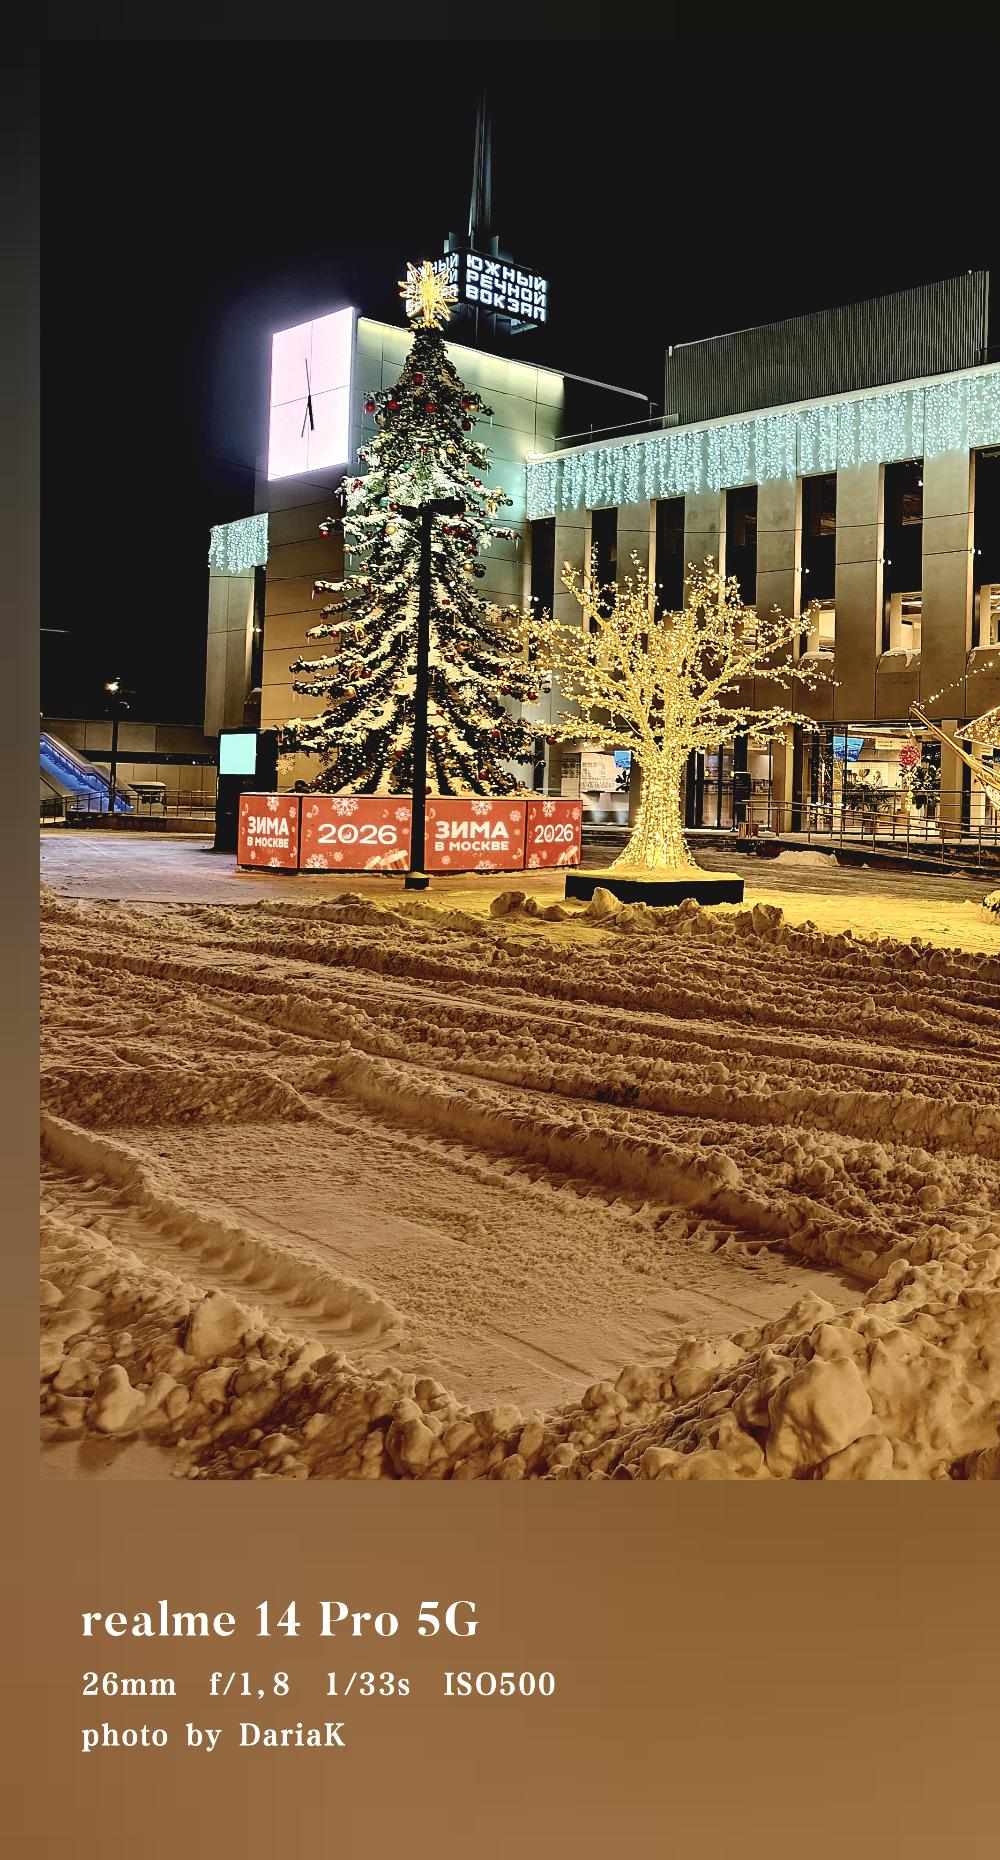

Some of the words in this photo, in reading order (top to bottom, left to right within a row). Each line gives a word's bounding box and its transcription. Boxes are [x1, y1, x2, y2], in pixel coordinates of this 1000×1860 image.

[466, 254, 547, 292] ЮЖНЫЙ
[466, 268, 546, 307] РЕЧНОЙ
[465, 284, 546, 322] ВОКЗАЛ
[247, 815, 289, 837] ЗИМА
[317, 823, 398, 845] 2026
[435, 820, 509, 839] ЗИМА
[534, 823, 574, 844] 2026
[247, 836, 254, 847] В
[255, 836, 289, 849] МОСКВЕ
[435, 841, 445, 852] В
[448, 840, 509, 852] МОСКВЕ
